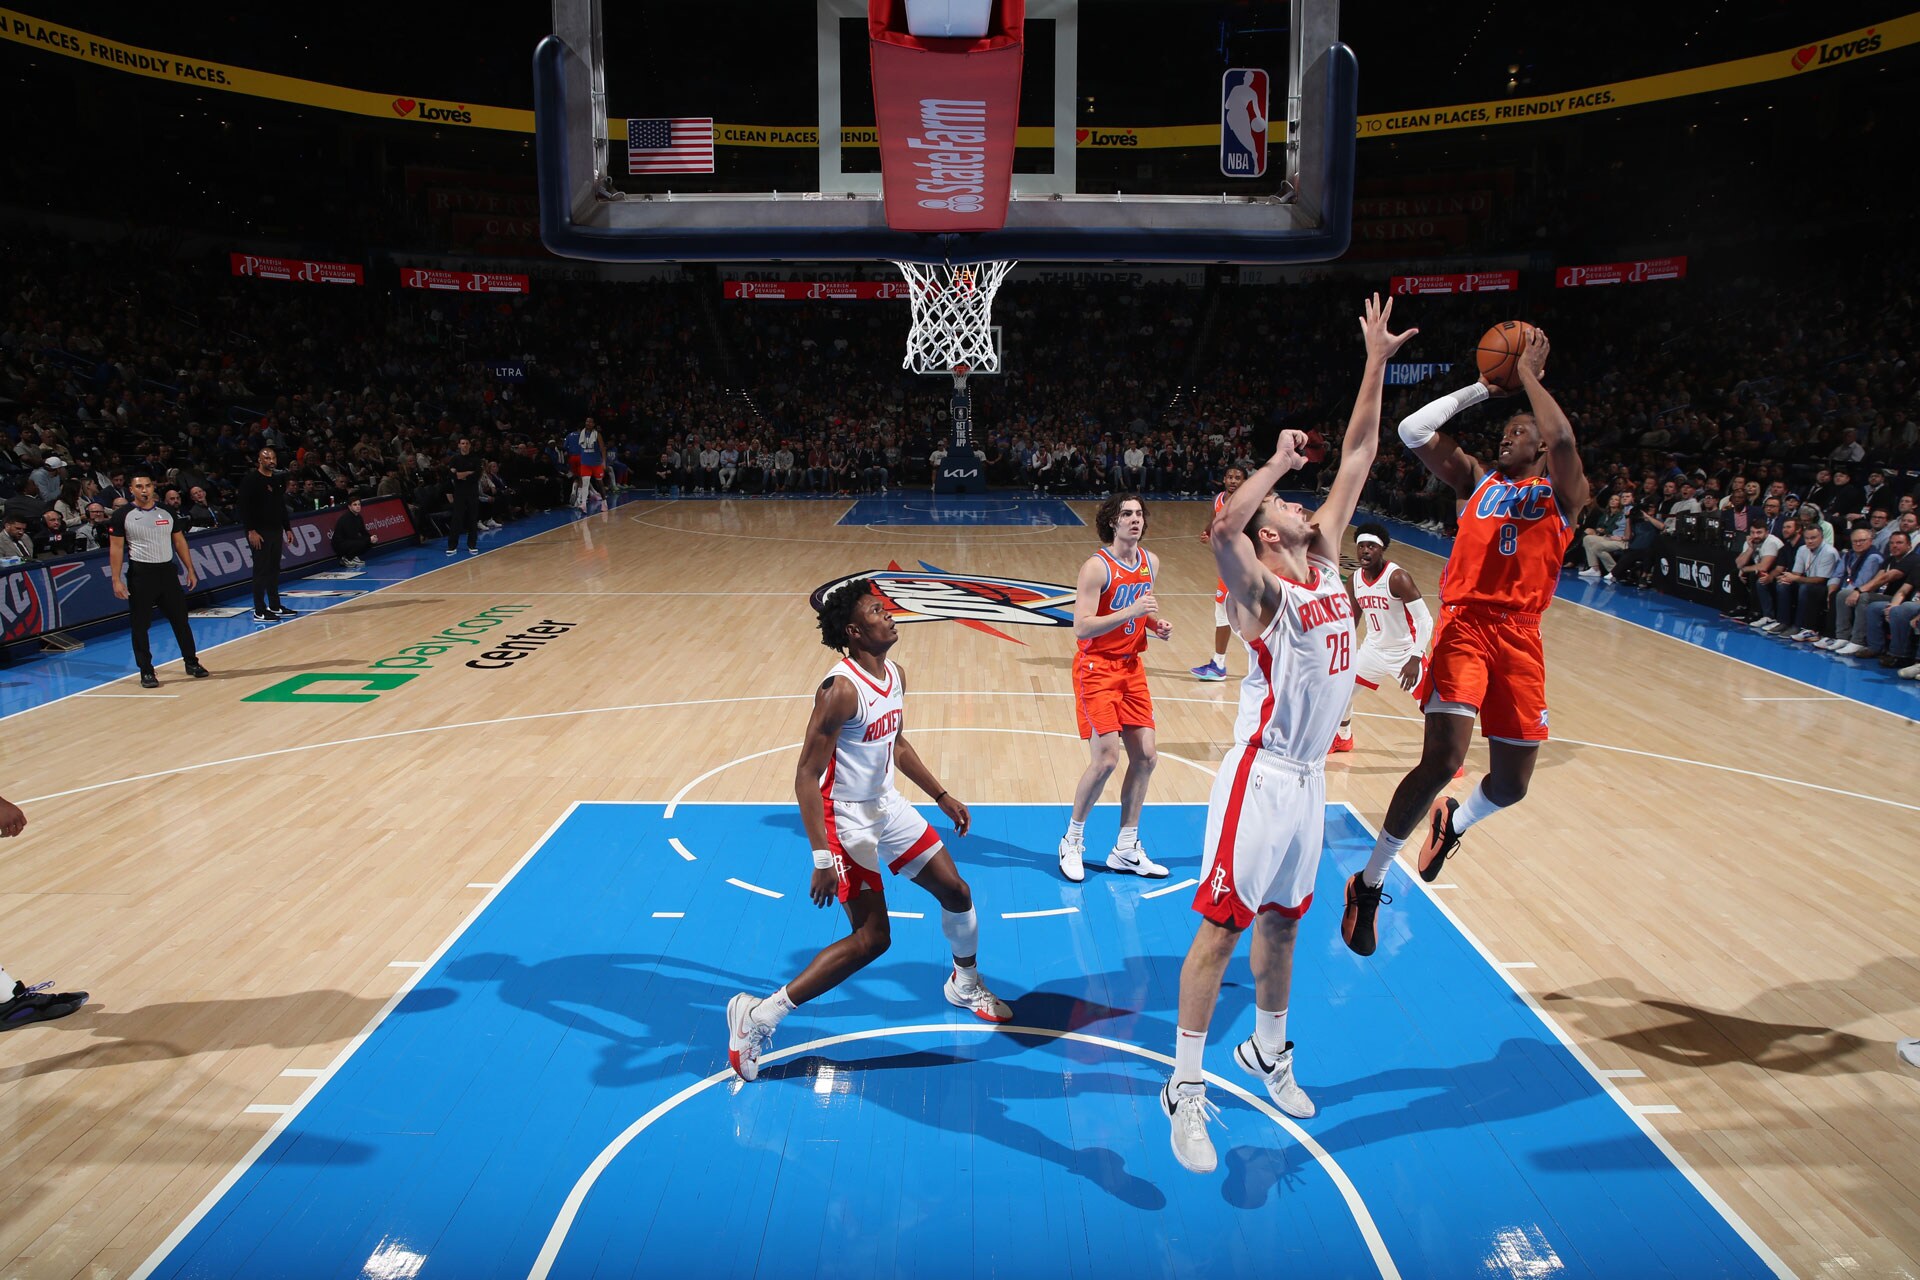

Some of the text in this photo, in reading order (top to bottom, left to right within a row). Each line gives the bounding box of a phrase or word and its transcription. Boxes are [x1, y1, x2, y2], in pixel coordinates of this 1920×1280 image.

[13, 19, 86, 55] PLACES,
[90, 42, 169, 73] FRIENDLY
[174, 62, 231, 85] FACES.
[1366, 119, 1382, 132] TO
[1386, 115, 1431, 130] CLEAN
[1434, 109, 1490, 125] PLACES,
[1494, 99, 1564, 119] FRIENDLY
[1568, 90, 1616, 109] FACES.
[724, 130, 767, 143] CLEAN
[1227, 152, 1249, 170] NBA
[955, 421, 966, 430] GET
[956, 430, 967, 439] THE
[955, 439, 967, 447] APP
[1476, 484, 1552, 520] OKC
[283, 524, 321, 557] UP
[1499, 523, 1518, 555] 8
[367, 604, 533, 669] paycom
[1369, 613, 1381, 632] 0
[465, 619, 578, 670] center
[1326, 631, 1350, 676] 28
[885, 741, 892, 774] 1
